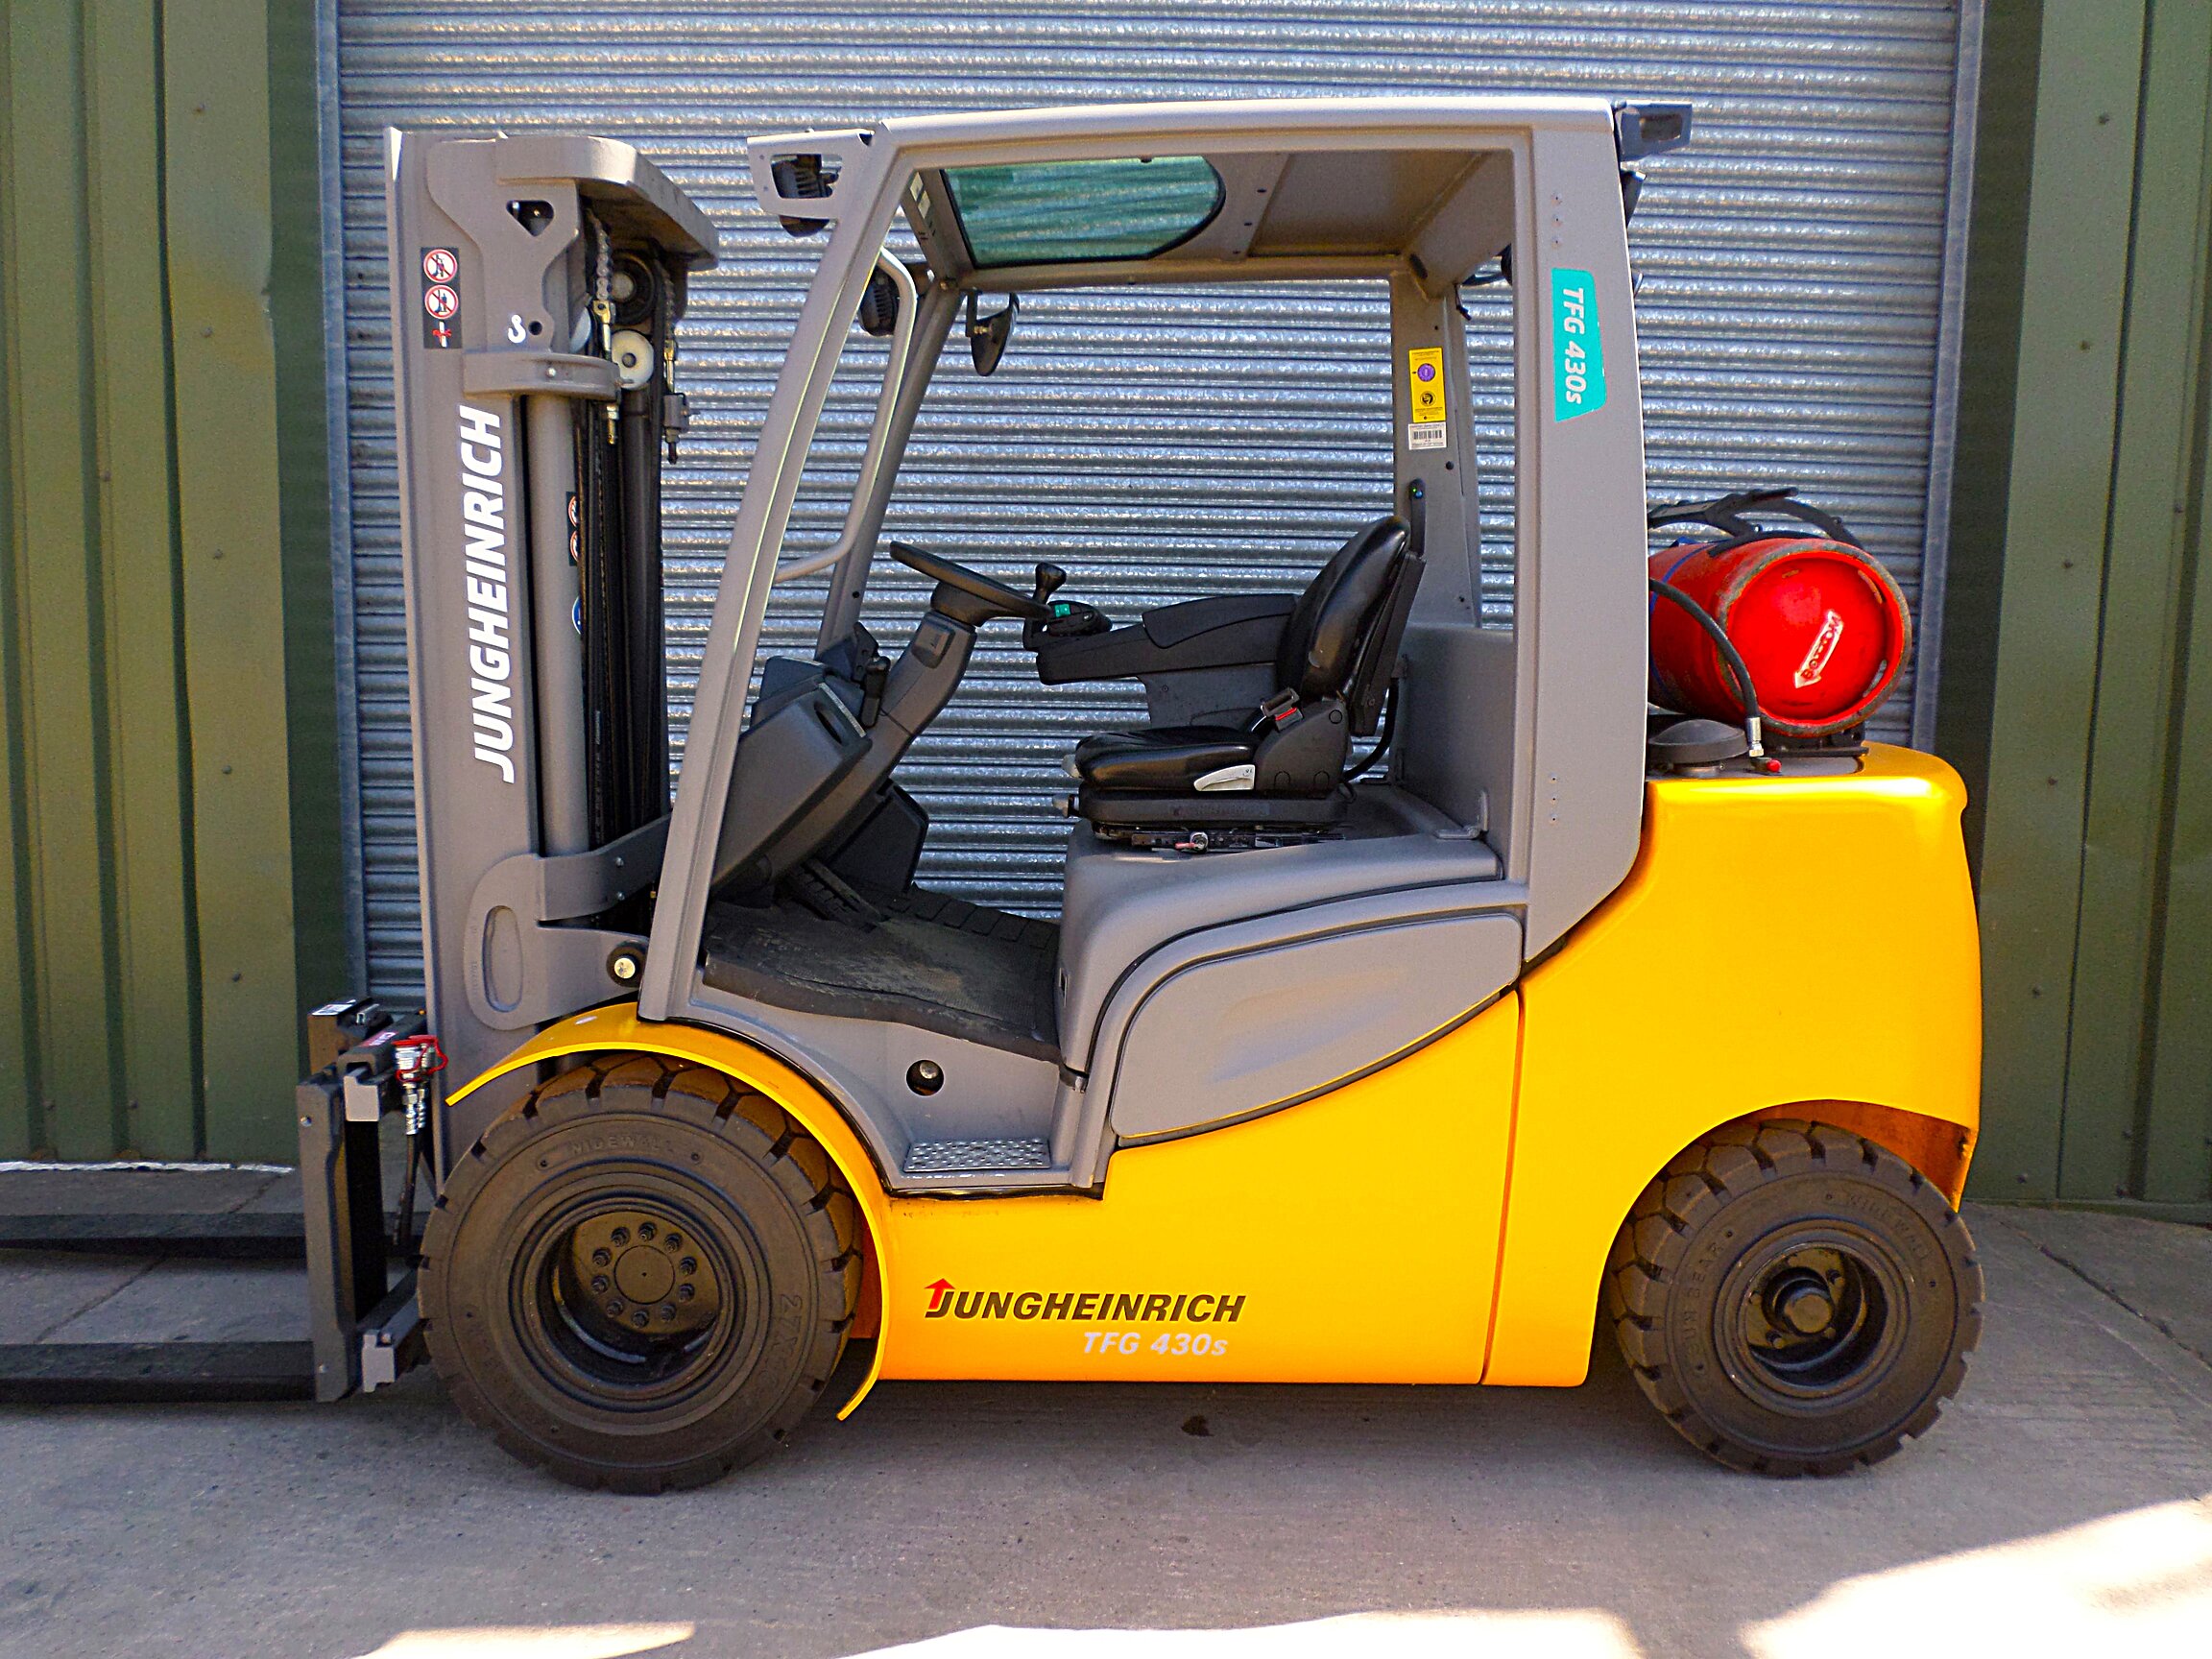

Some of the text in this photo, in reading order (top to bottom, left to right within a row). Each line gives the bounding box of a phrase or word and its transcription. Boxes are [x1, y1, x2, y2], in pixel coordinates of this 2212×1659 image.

[1562, 287, 1587, 404] TFG 430s
[458, 404, 516, 785] JUNGHEINRICH
[925, 1291, 1246, 1323] JUNGHEINRICH
[1083, 1331, 1229, 1357] TFG 430s
